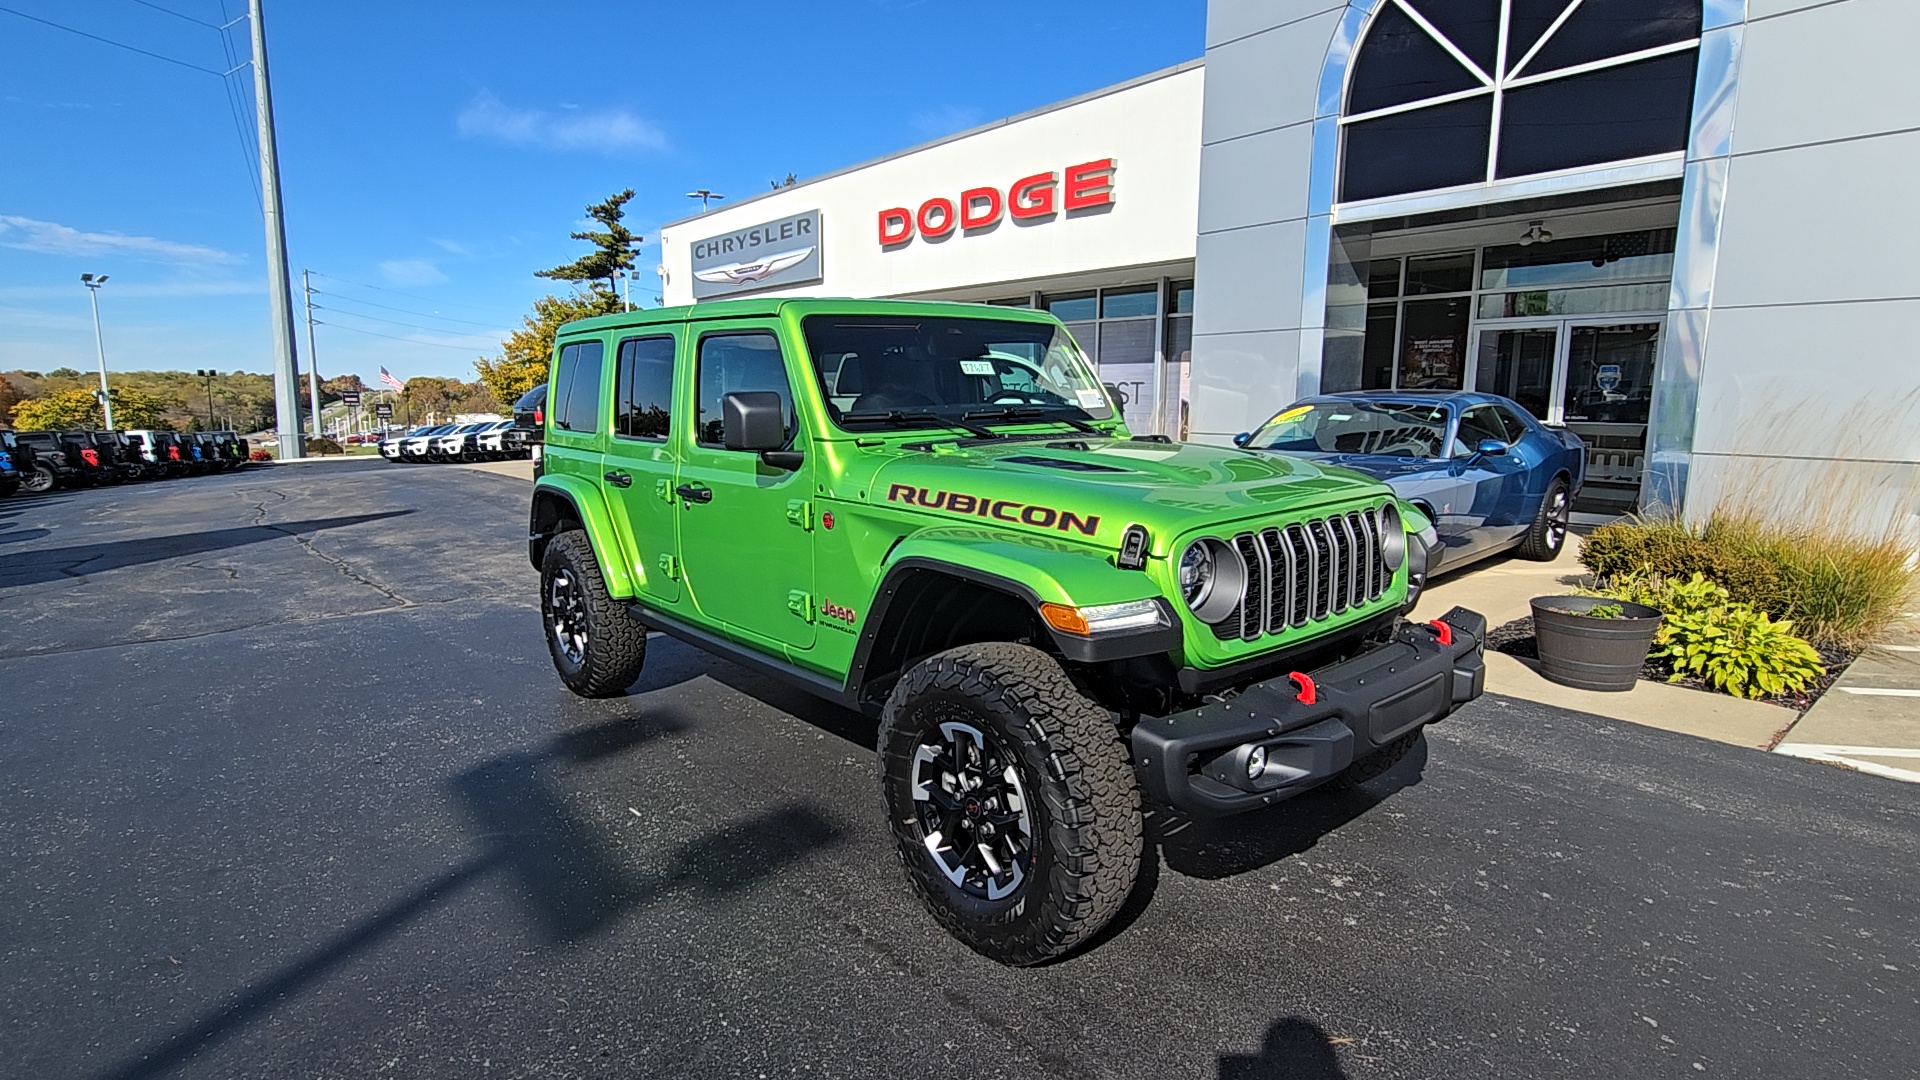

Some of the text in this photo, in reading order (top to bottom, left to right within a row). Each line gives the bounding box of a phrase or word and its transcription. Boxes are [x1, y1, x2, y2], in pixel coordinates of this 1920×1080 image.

[878, 158, 1117, 247] DODGE
[695, 218, 812, 260] CHRYSLER
[887, 483, 1101, 536] RUBICON
[820, 598, 856, 626] Jeep
